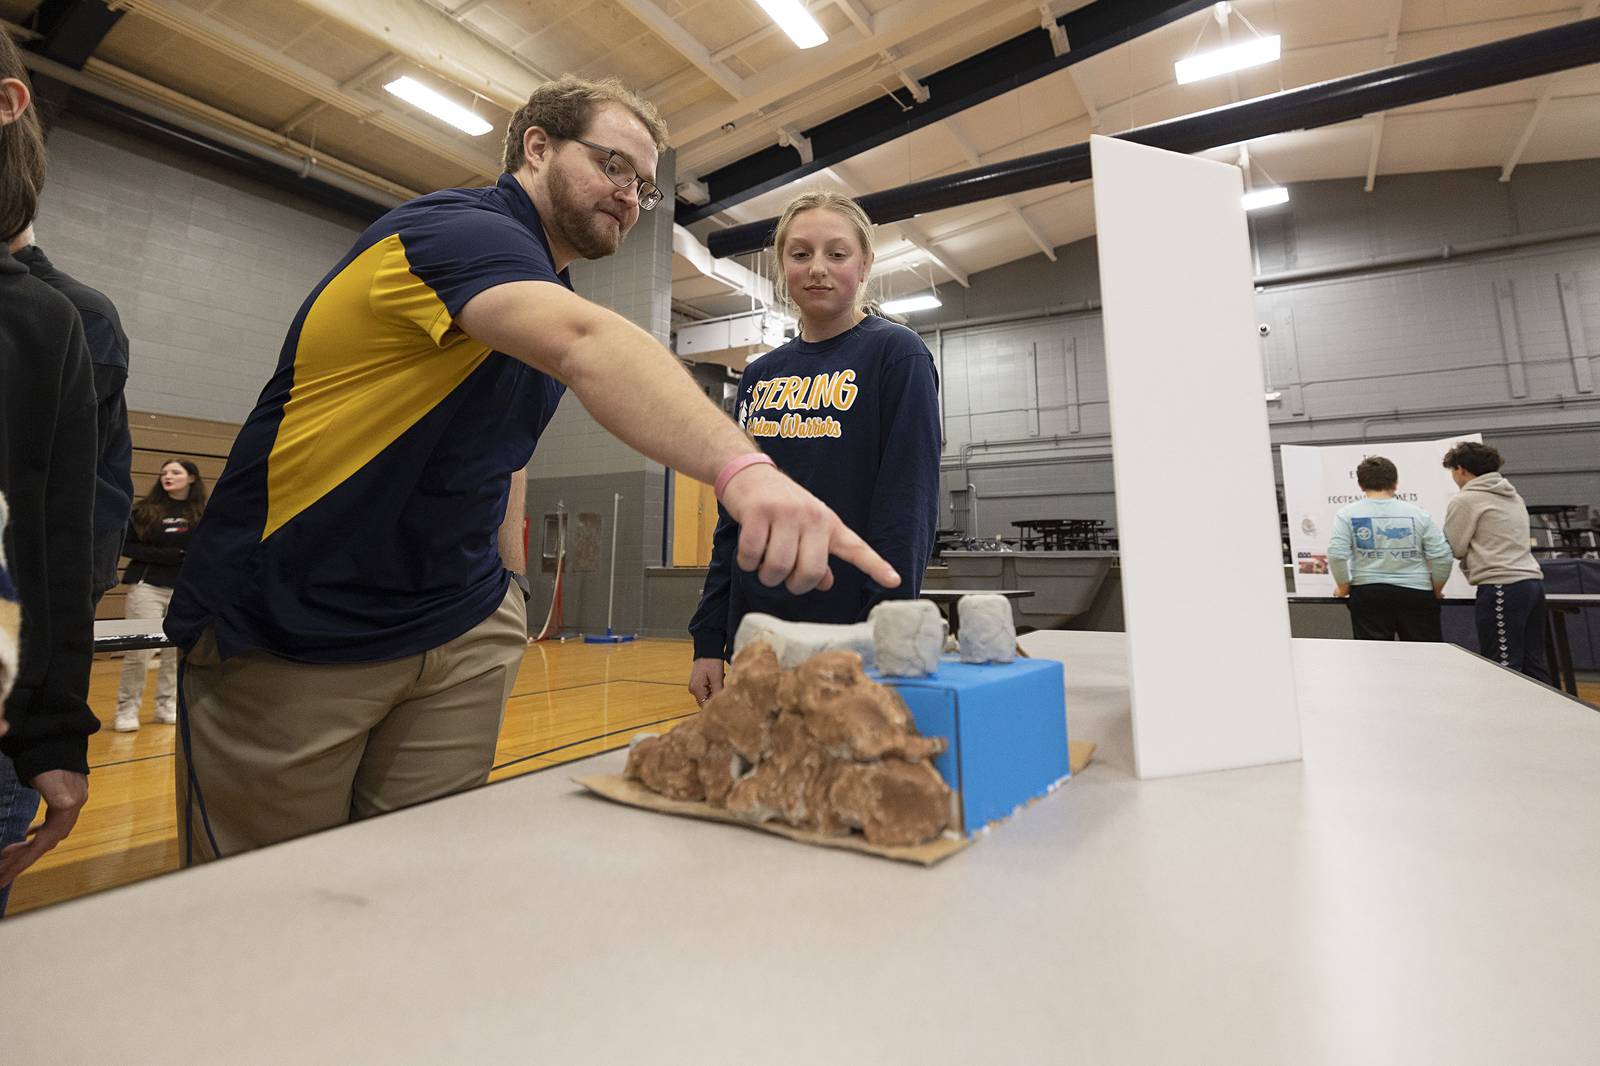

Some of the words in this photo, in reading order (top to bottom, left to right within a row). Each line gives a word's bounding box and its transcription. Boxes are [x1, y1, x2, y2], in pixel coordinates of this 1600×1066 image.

[748, 369, 858, 416] STERLING
[780, 413, 841, 438] Warriors
[1359, 551, 1384, 560] YEE
[1390, 550, 1418, 560] YEE
